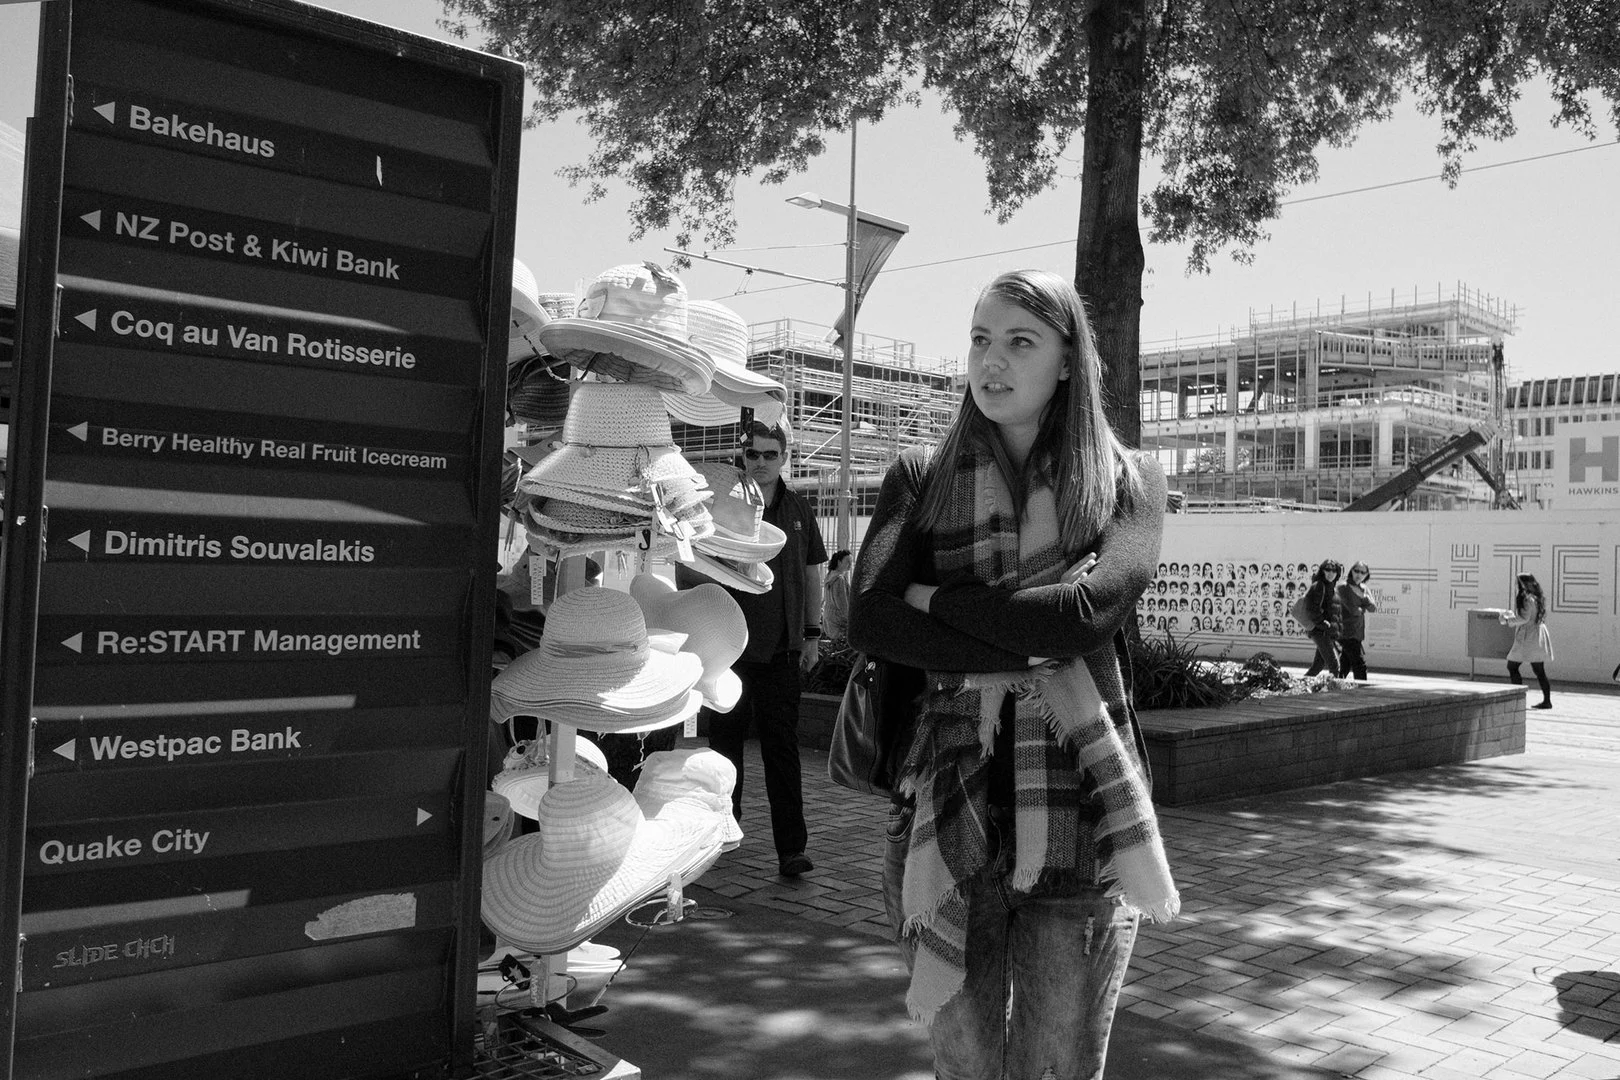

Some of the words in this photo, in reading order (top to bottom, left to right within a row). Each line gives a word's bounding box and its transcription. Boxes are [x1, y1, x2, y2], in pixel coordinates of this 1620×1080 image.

[129, 104, 275, 158] Bakehaus
[116, 211, 160, 241] NZ
[169, 221, 235, 254] Post
[243, 234, 263, 258] &
[271, 238, 328, 268] Kiwi
[336, 249, 400, 280] Bank
[110, 310, 174, 346] Coq
[182, 325, 219, 346] au
[227, 324, 278, 353] Van
[287, 332, 416, 369] Rotisserie
[102, 427, 166, 459] Berry
[172, 432, 255, 459] Healthy
[260, 439, 306, 460] Real
[312, 443, 357, 463] Fruit
[362, 447, 447, 469] Icecream
[1568, 436, 1619, 483] H
[1568, 487, 1619, 496] HAWKINS
[104, 530, 222, 558] Dimitris
[230, 535, 375, 562] Souvalakis
[1450, 544, 1480, 609] THE
[1493, 544, 1620, 615] TE
[97, 630, 246, 655] Re:START
[253, 629, 421, 656] Management
[89, 734, 222, 762] Westpac
[230, 726, 302, 752] Bank
[39, 834, 142, 866] Quake
[151, 828, 210, 855] City
